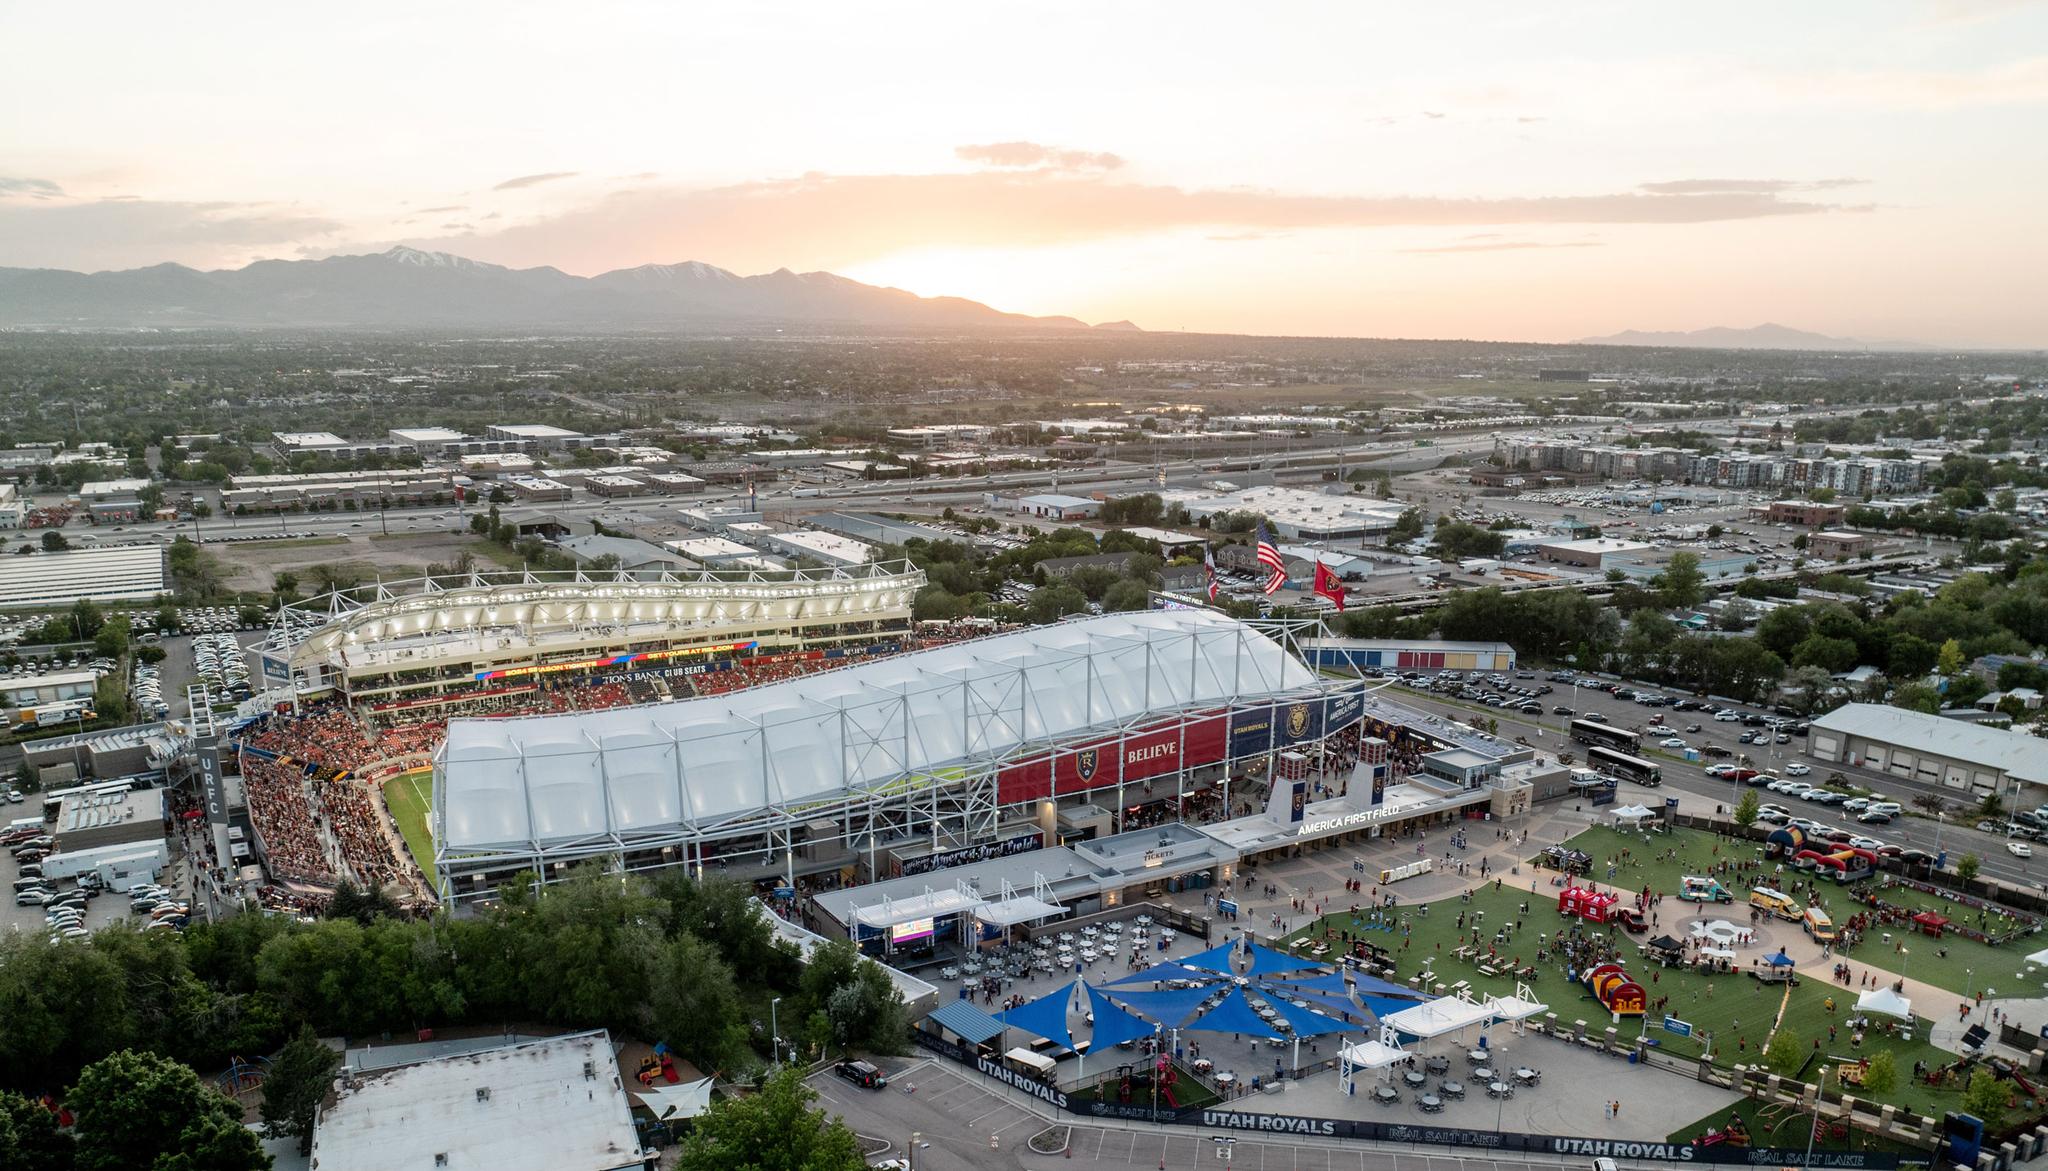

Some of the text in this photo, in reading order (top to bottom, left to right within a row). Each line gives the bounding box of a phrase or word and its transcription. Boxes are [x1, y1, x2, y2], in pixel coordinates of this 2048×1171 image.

[663, 649, 690, 657] YOURS
[684, 665, 706, 674] SEATS
[1348, 700, 1360, 712] FIRST
[1128, 742, 1176, 764] BELIEVE
[202, 758, 218, 814] URFC
[1298, 805, 1399, 836] AMERICA FIRST FIELD
[1144, 850, 1174, 861] TICKETS
[978, 1058, 1067, 1108] UTAH ROYALS
[1119, 1107, 1145, 1117] SALT
[1204, 1112, 1334, 1134] UTAH ROYALS
[1389, 1126, 1499, 1146] REAL SALT LAKE
[1555, 1139, 1693, 1160] UTAH ROYALS
[1748, 1150, 1864, 1166] REAL SALT LAKE
